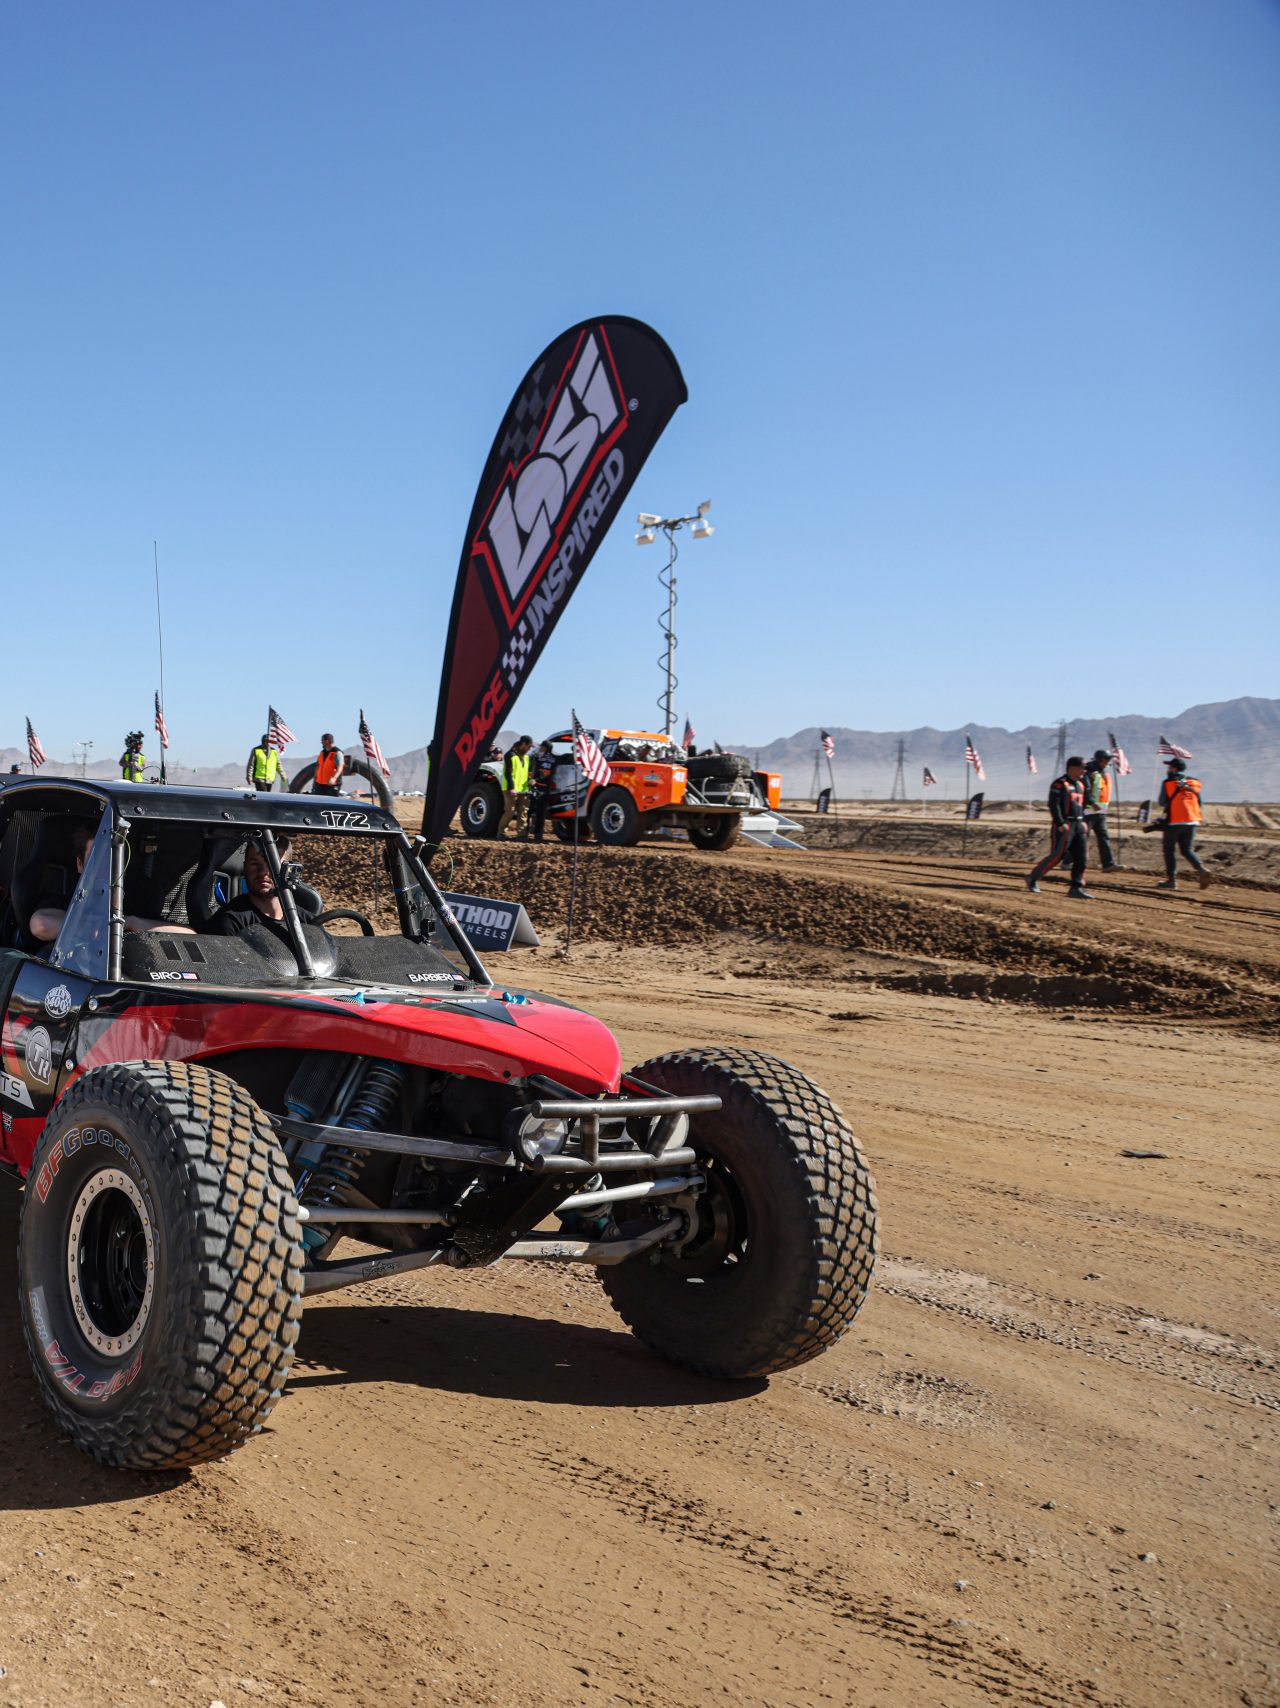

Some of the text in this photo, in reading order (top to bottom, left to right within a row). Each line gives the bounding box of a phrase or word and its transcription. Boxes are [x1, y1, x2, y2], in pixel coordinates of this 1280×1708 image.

[488, 332, 618, 601] LOSI
[454, 447, 625, 772] RACE INSPIRED
[320, 810, 371, 829] 172
[149, 971, 183, 980] BIRO
[408, 974, 455, 982] BARBIERI
